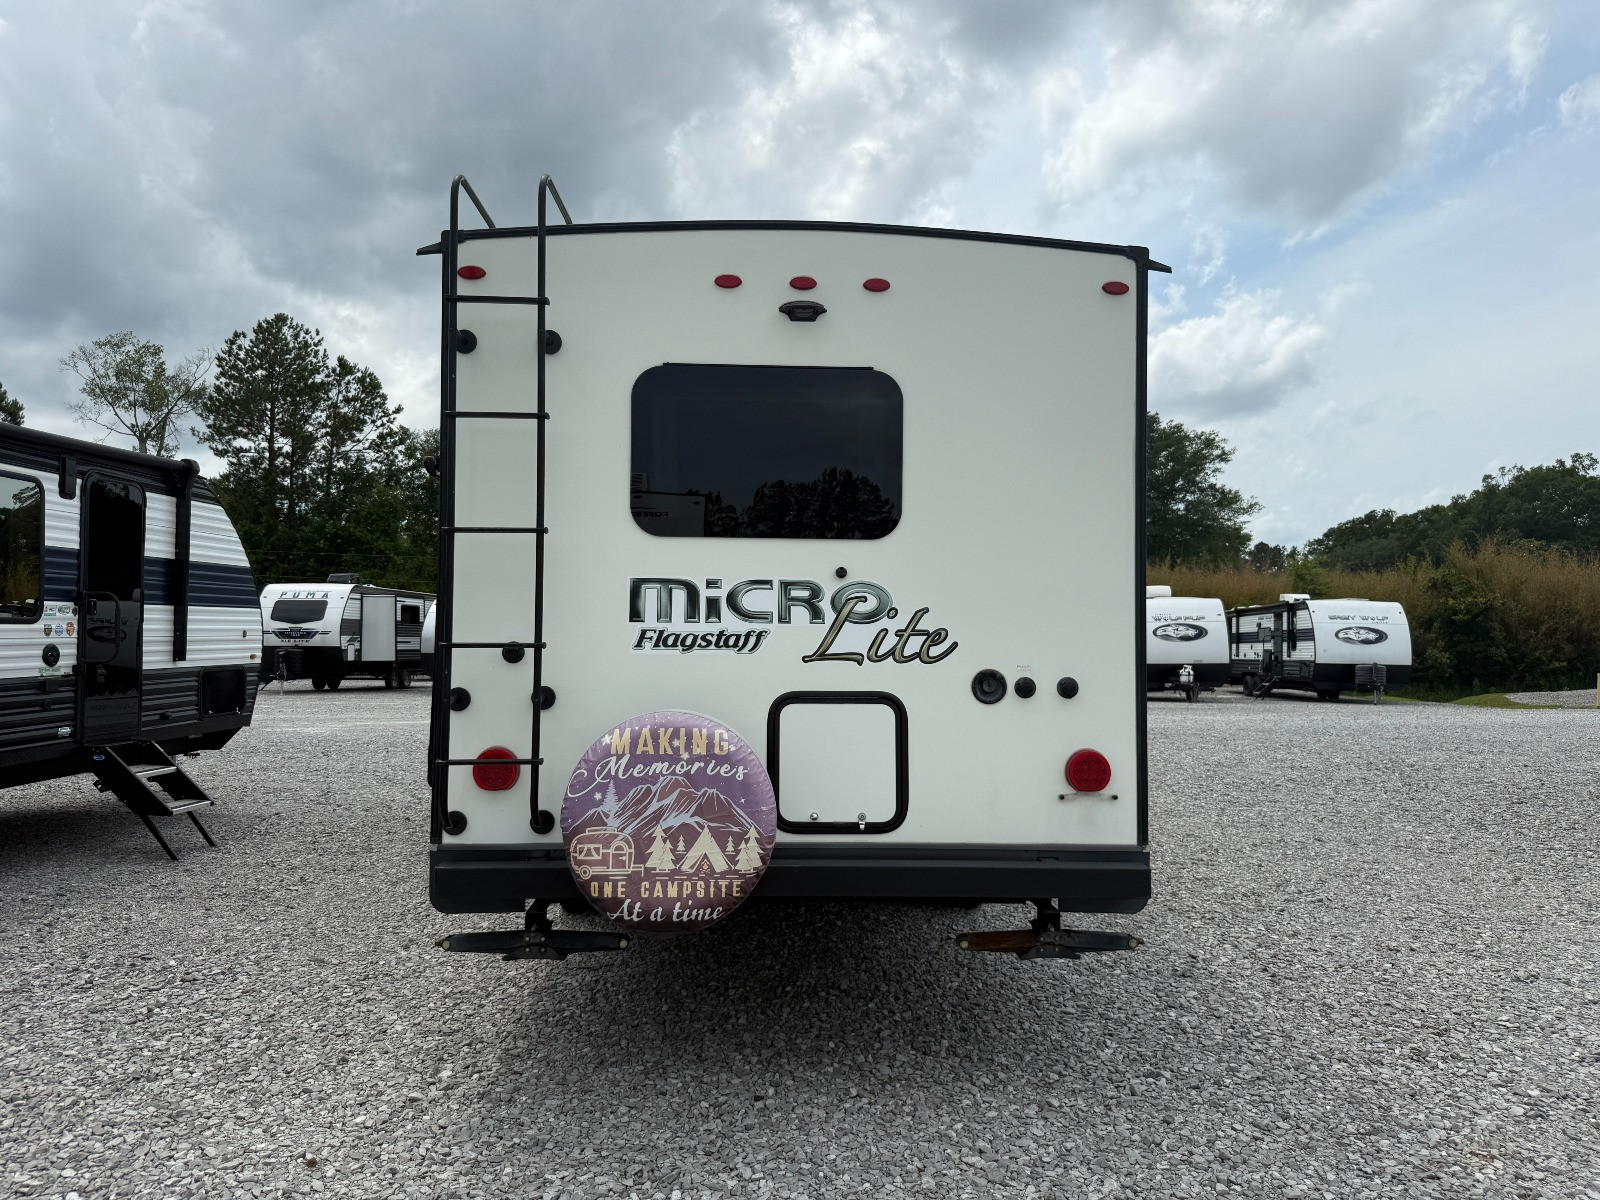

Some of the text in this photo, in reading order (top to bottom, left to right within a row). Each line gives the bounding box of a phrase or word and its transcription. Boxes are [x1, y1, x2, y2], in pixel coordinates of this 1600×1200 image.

[633, 628, 769, 654] Flagstaff
[802, 595, 959, 666] Lite
[610, 727, 731, 756] MAKING
[567, 754, 748, 797] Memories
[590, 881, 741, 898] ONE CAMPSITE
[607, 898, 726, 922] At a time
